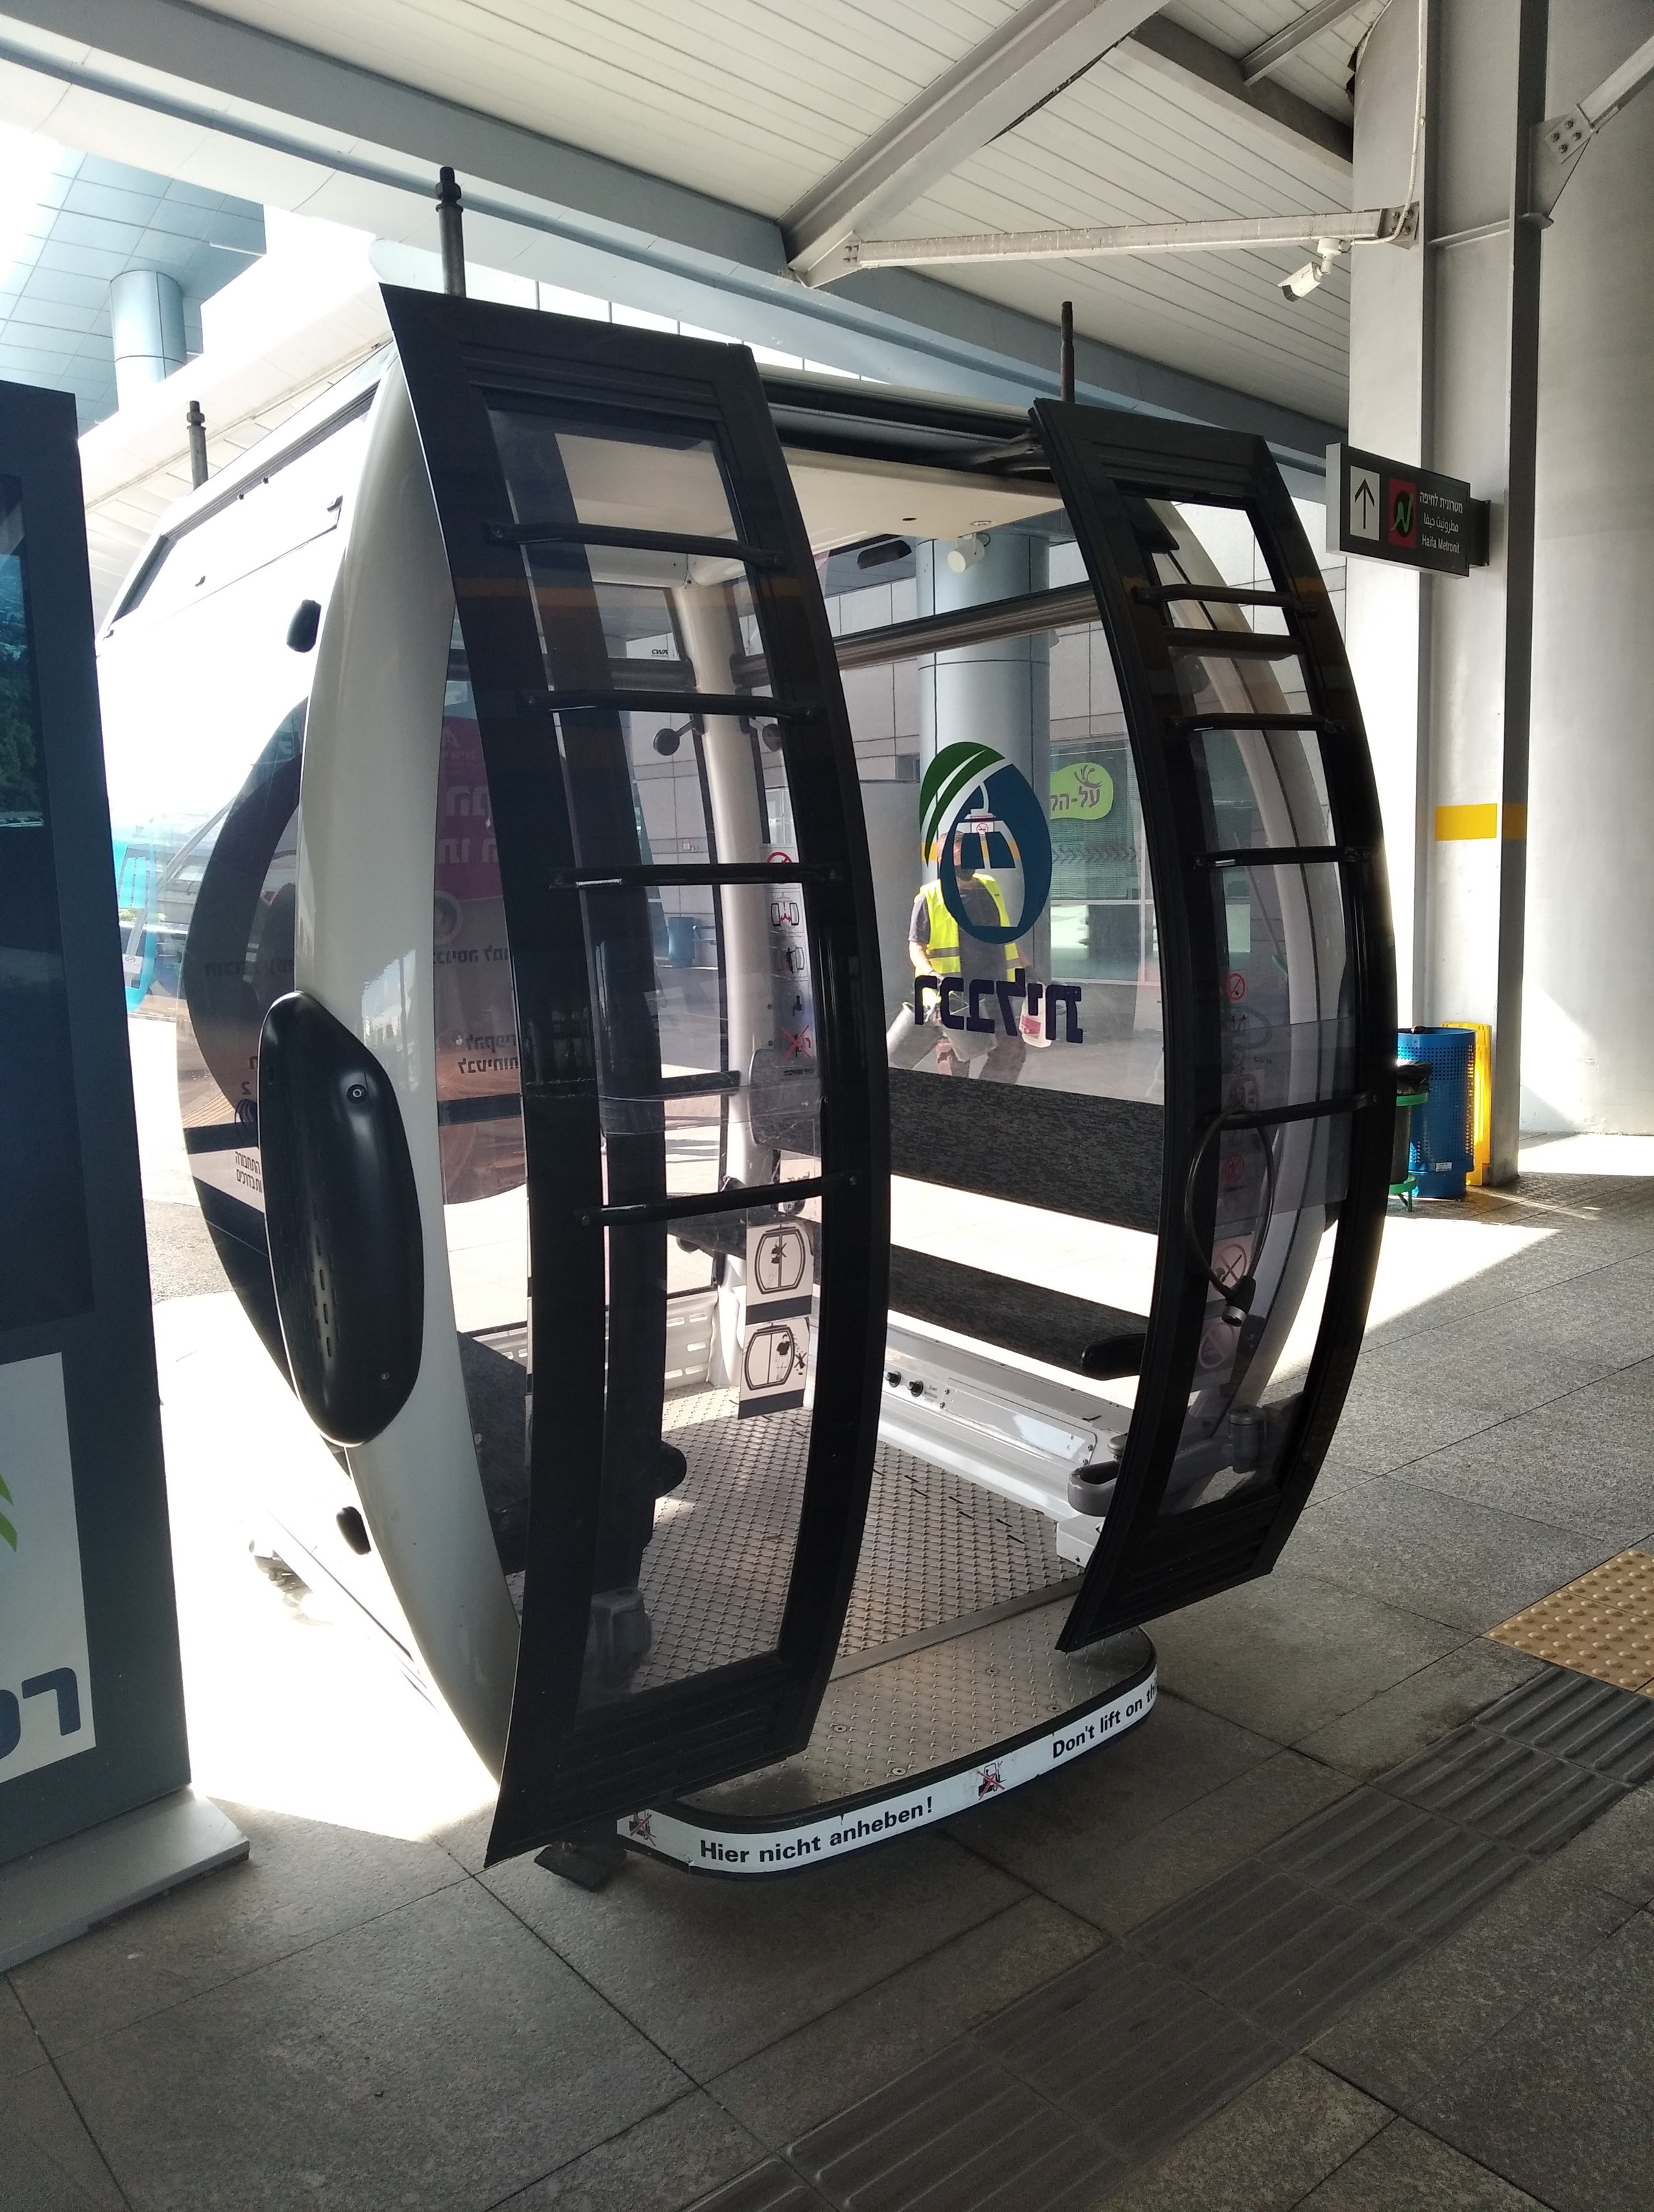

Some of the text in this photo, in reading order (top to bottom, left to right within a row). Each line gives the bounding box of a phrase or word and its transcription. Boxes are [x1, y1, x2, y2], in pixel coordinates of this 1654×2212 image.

[1419, 491, 1463, 514] מטרונית לחיפה
[1424, 512, 1435, 528] حيفا
[1422, 534, 1460, 554] Haifa Metronit
[1053, 1725, 1094, 1759] Don't
[1100, 1709, 1121, 1733] lift
[1125, 1699, 1142, 1717] on
[700, 1840, 750, 1863] Hier
[759, 1835, 821, 1862] nicht
